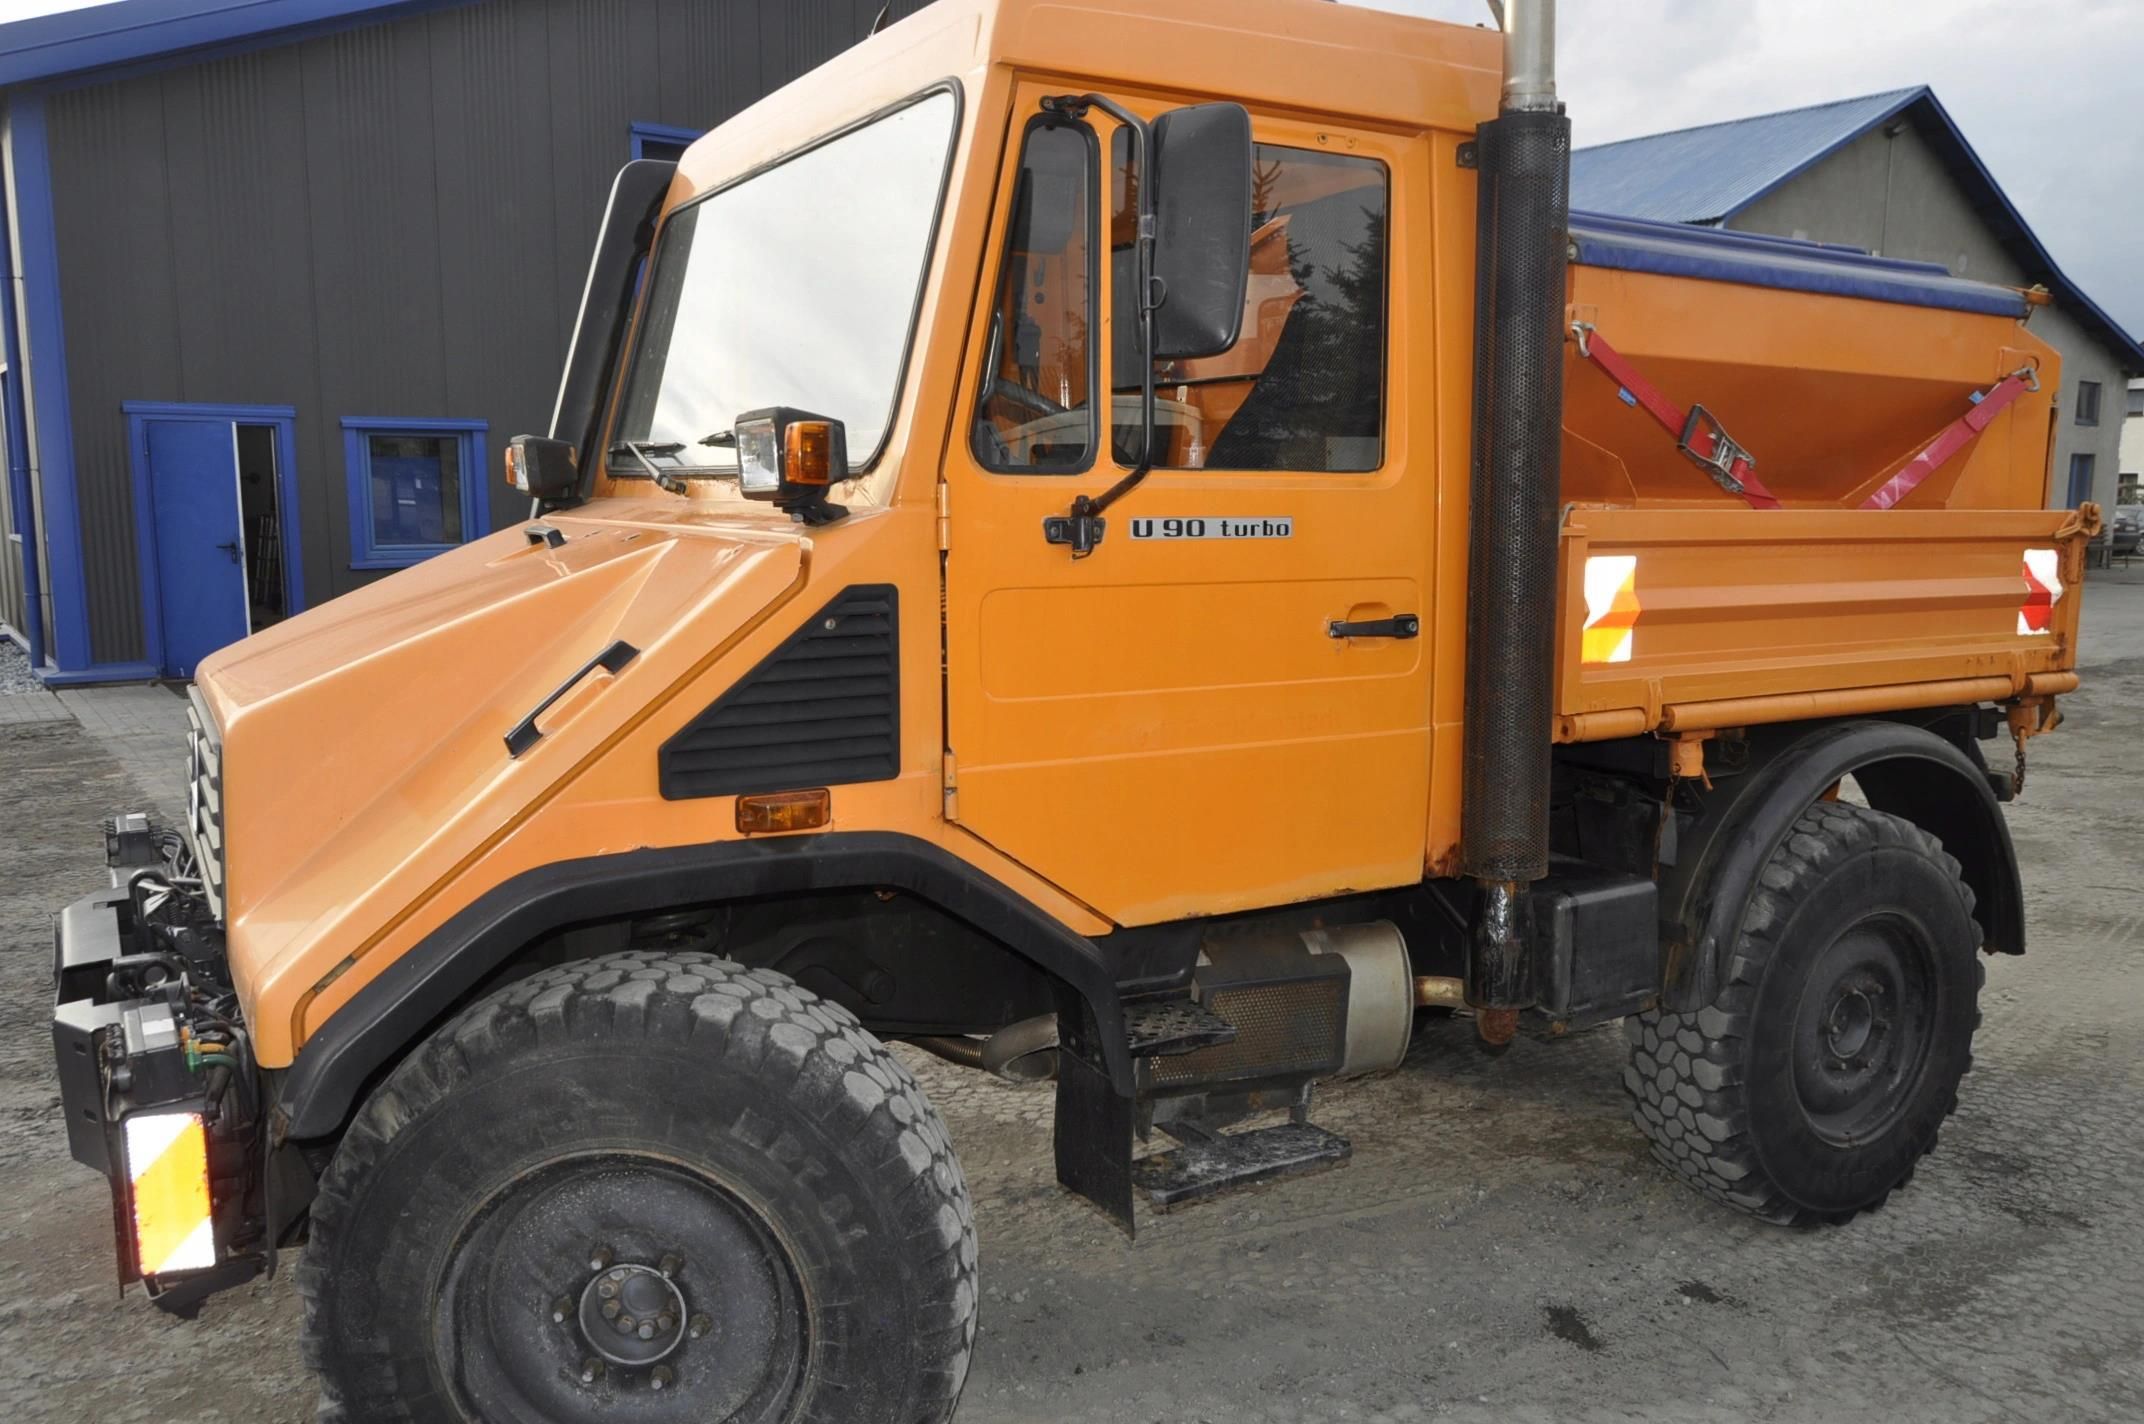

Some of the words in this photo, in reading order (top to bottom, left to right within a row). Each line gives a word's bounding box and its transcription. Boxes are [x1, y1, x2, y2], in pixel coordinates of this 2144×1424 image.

[1132, 519, 1153, 538] U
[1162, 519, 1206, 538] 90
[1220, 519, 1290, 537] turbo
